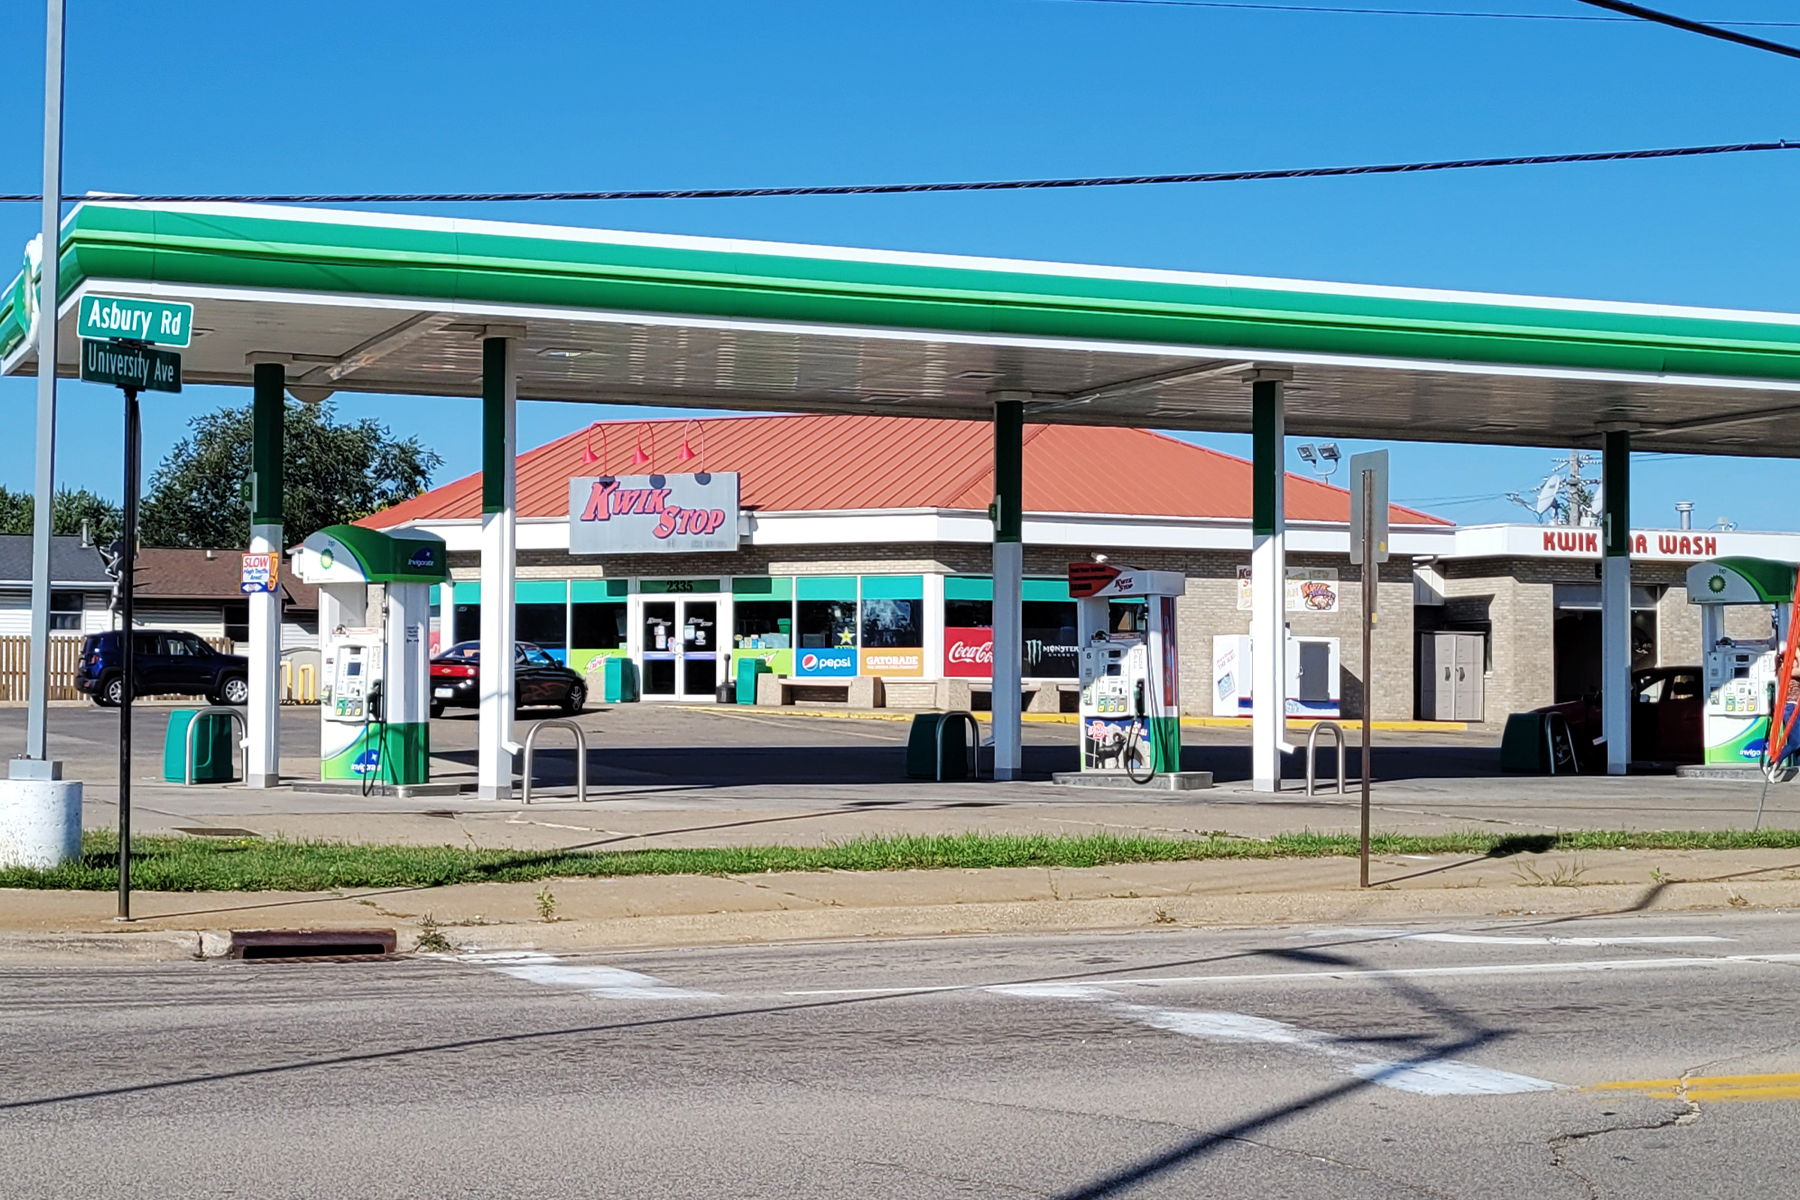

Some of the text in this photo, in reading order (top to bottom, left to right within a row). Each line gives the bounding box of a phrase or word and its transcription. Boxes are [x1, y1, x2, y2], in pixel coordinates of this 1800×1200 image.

[88, 299, 182, 340] Asbury Rd
[88, 342, 175, 386] University Ave
[244, 485, 250, 497] 8
[580, 481, 672, 522] KWIK
[652, 505, 726, 539] STOP
[1543, 531, 1598, 553] KWIK
[1658, 534, 1717, 556] WASH
[243, 557, 268, 568] SLOW
[666, 580, 693, 592] 2335
[1042, 645, 1079, 653] MONSTER
[866, 656, 919, 665] GATORADE
[1087, 652, 1092, 660] 6
[819, 656, 851, 670] pepsi
